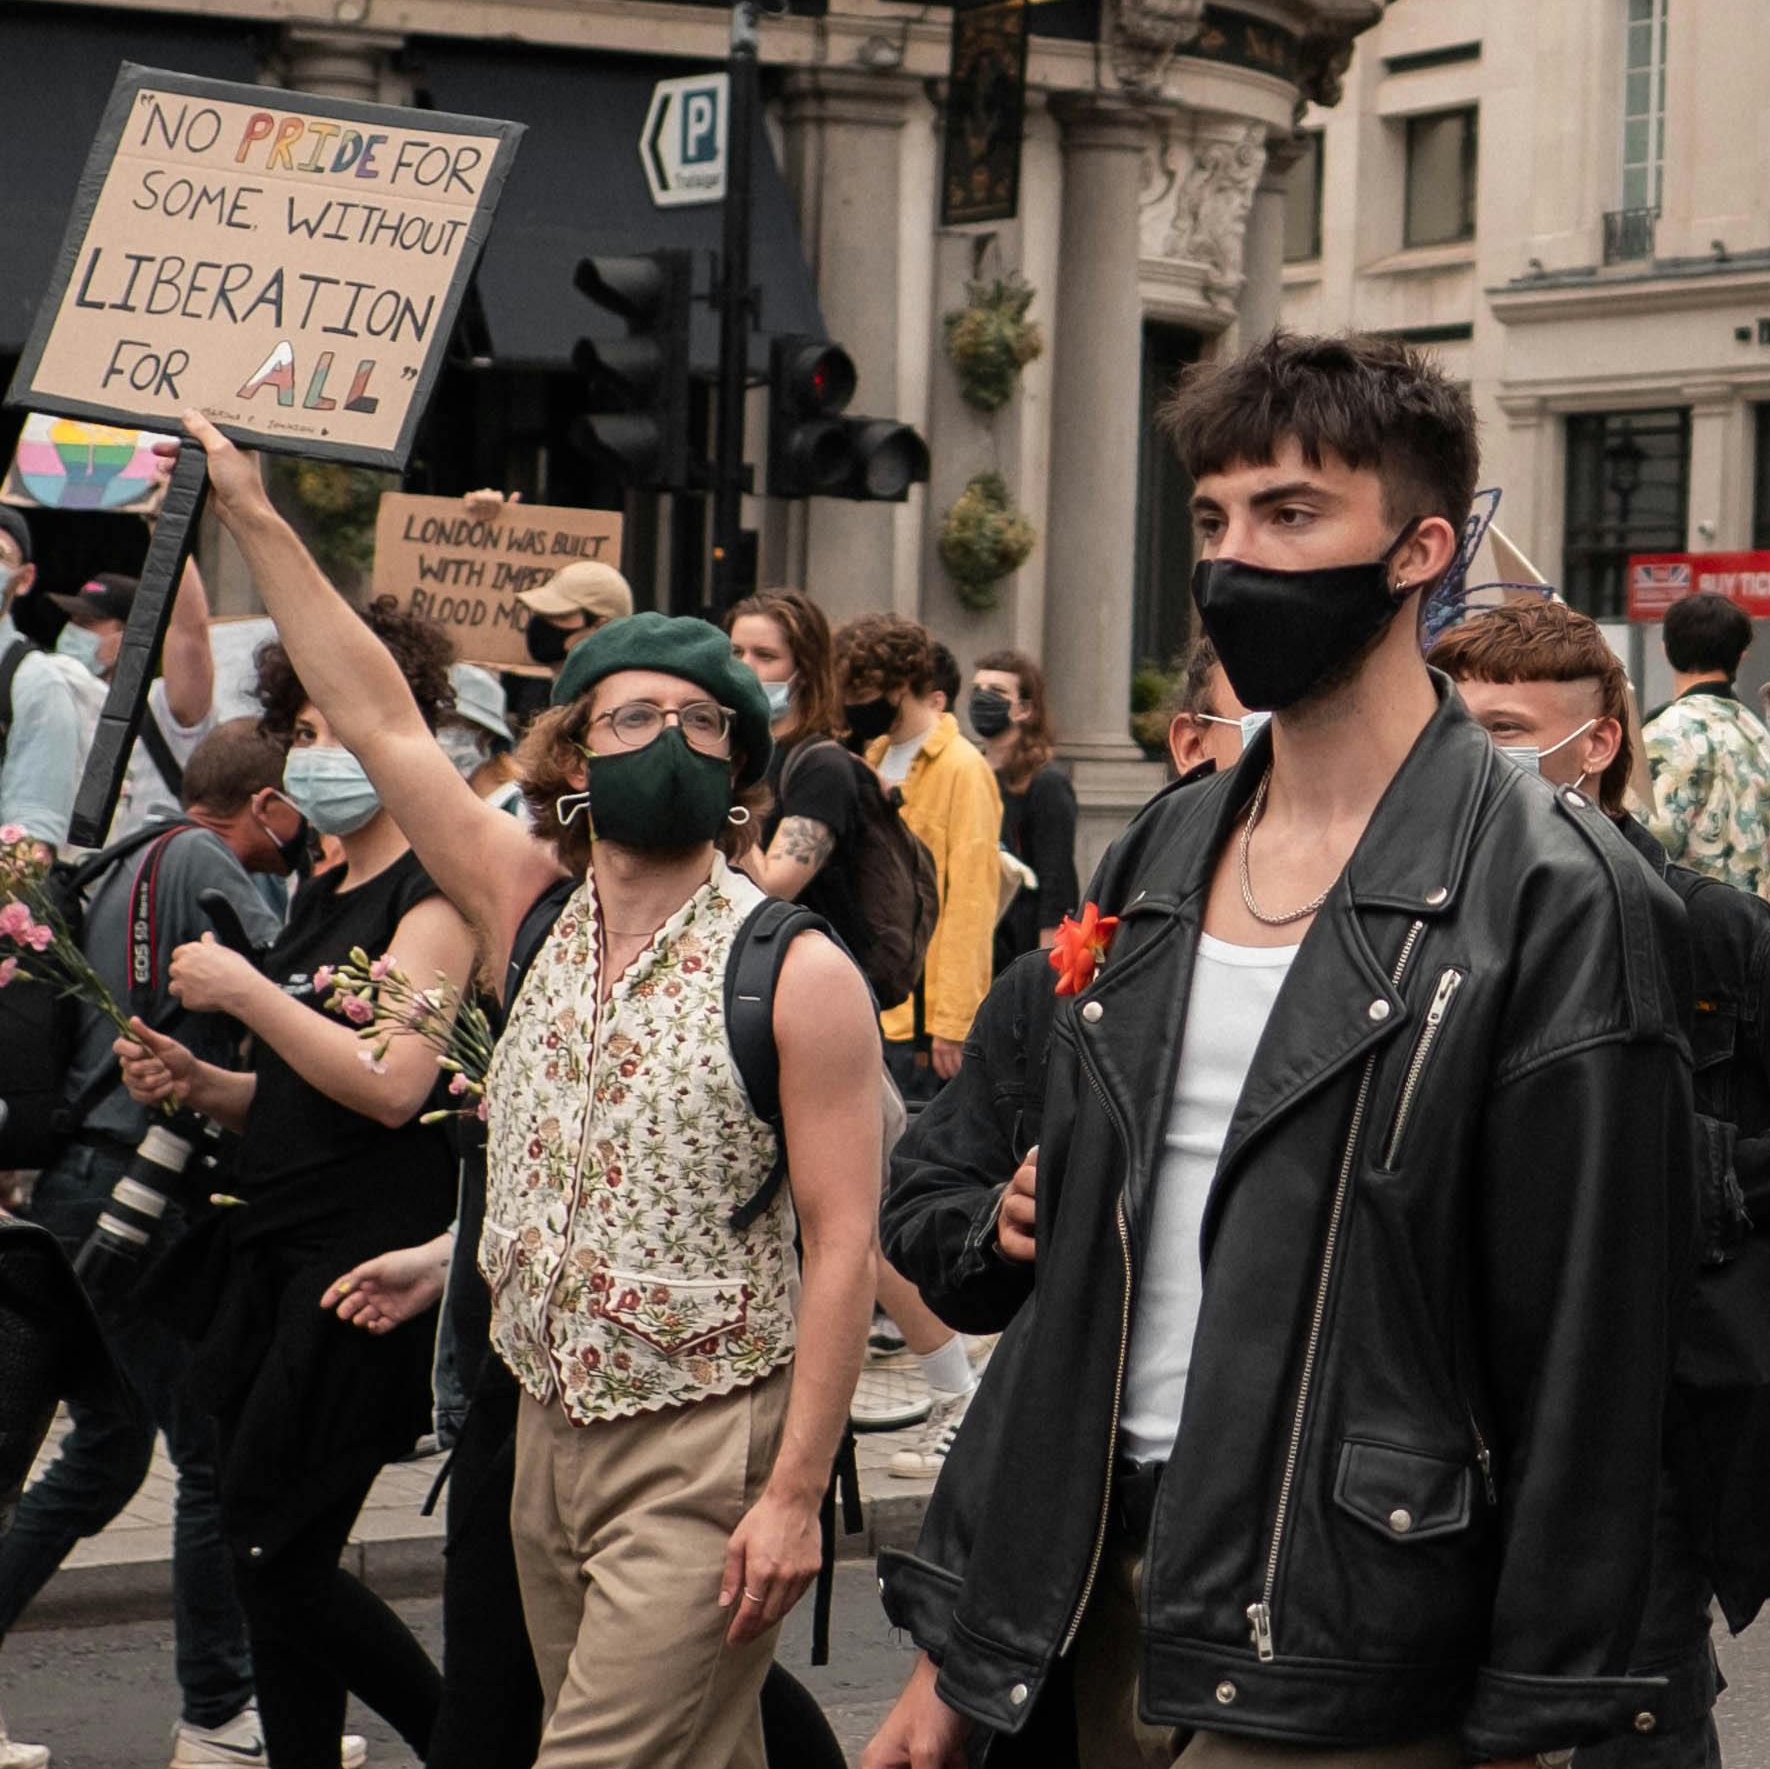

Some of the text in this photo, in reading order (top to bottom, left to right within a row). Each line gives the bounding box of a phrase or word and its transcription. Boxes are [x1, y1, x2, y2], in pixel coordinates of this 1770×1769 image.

[235, 111, 388, 178] PRIDE
[390, 141, 482, 195] FOR
[687, 96, 712, 158] P
[288, 197, 467, 256] WITHOUT
[75, 248, 435, 343] LIBERATION
[102, 340, 189, 400] FOR
[403, 513, 610, 558] LONDON WAS BUILT
[418, 553, 486, 587] WITH
[410, 587, 487, 627] BLOOD
[134, 943, 150, 982] EOS
